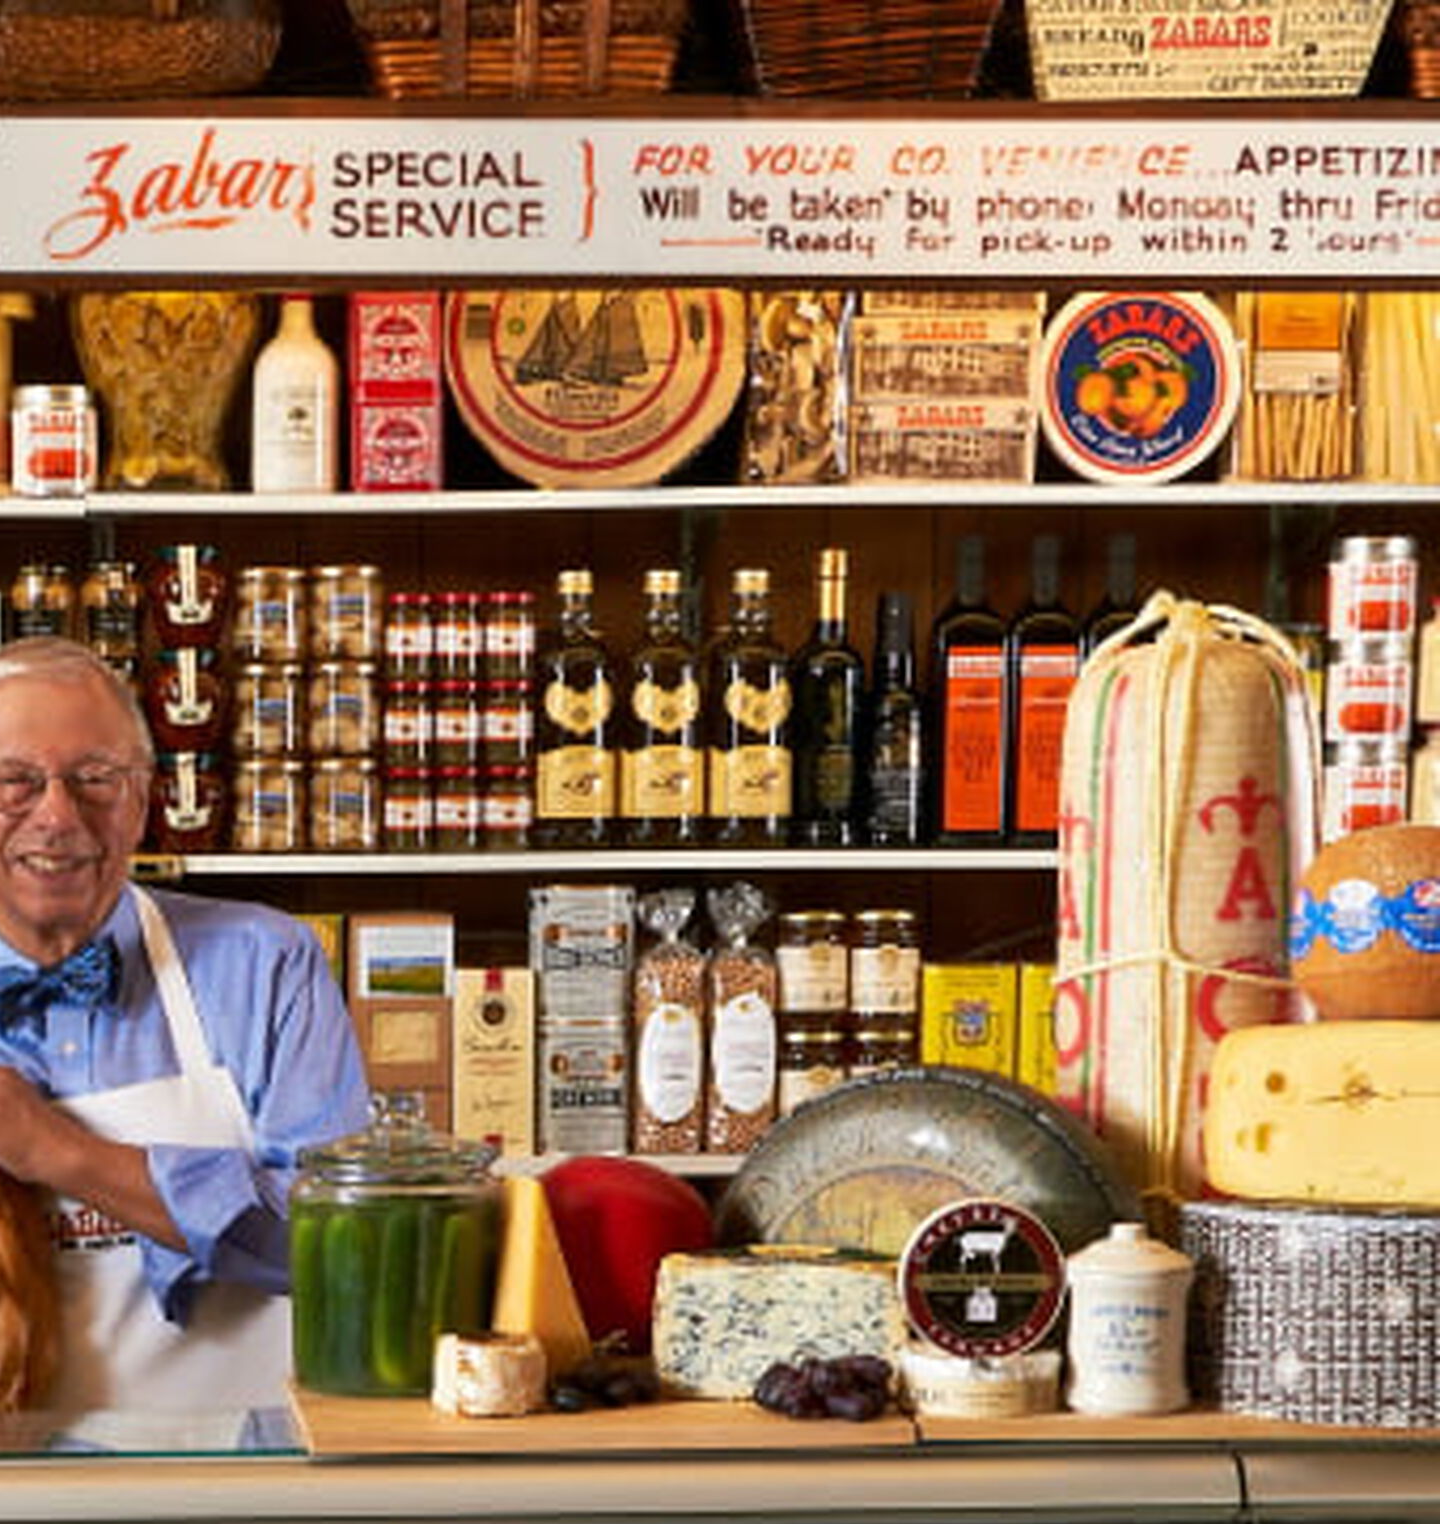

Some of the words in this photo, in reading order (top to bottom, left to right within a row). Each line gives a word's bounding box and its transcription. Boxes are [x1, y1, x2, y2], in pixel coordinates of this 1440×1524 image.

[332, 150, 545, 188] SPECIAL
[633, 144, 712, 176] FOR
[744, 144, 856, 176] YOUR
[331, 199, 546, 238] SERVICE
[639, 185, 700, 220] Will
[727, 187, 769, 221] be
[905, 188, 950, 227] by
[1279, 188, 1353, 221] thru
[981, 228, 1112, 259] pick-up
[1142, 226, 1249, 252] within
[1269, 229, 1290, 252] 2
